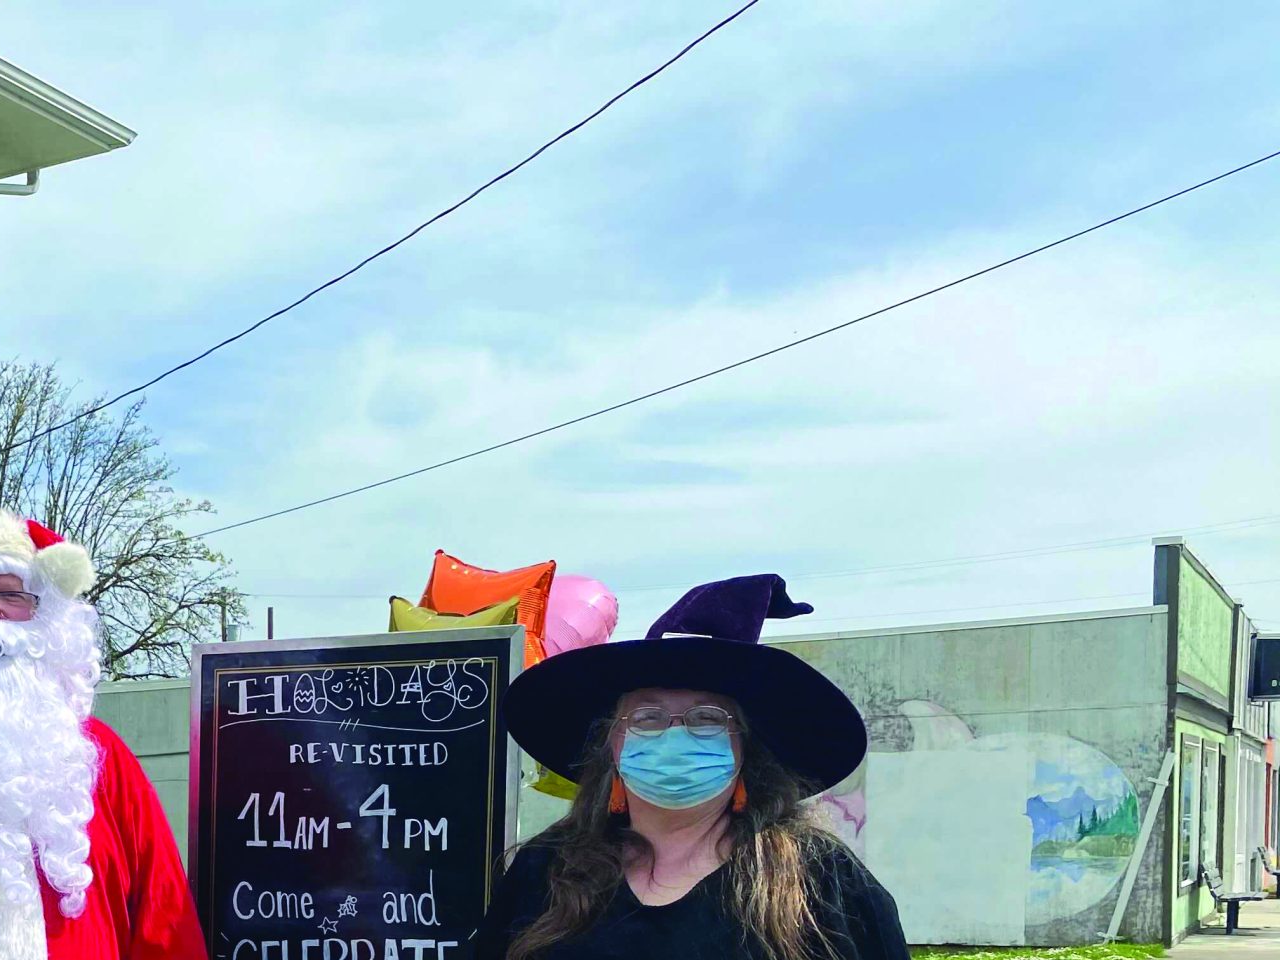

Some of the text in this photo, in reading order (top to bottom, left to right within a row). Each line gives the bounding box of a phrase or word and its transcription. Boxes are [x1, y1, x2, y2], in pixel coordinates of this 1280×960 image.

[289, 742, 449, 766] RE-VISITED
[232, 868, 441, 927] Come and
